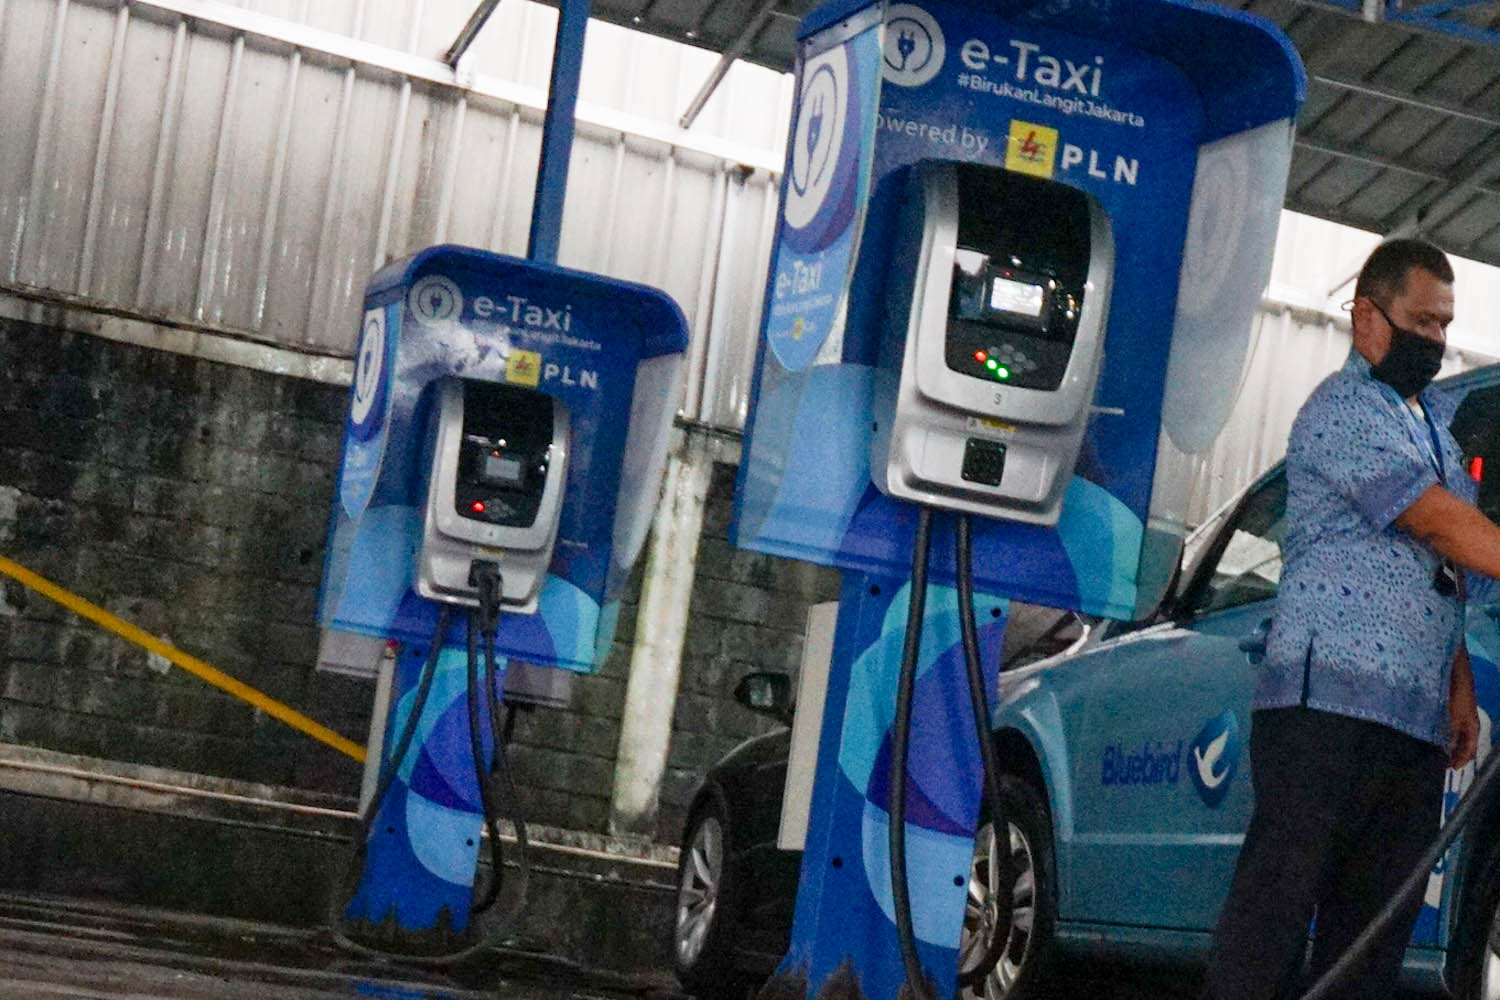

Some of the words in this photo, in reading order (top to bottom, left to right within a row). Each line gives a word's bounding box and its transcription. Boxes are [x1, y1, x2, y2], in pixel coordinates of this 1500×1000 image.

[961, 39, 1104, 97] e-Taxi
[957, 72, 1146, 128] #BirukanLangitJakarta
[874, 113, 957, 145] owered
[961, 126, 989, 153] by
[1061, 143, 1139, 186] PLN
[472, 295, 572, 332] e-Taxi
[544, 363, 598, 389] PLN
[1102, 740, 1183, 785] Bluebird
